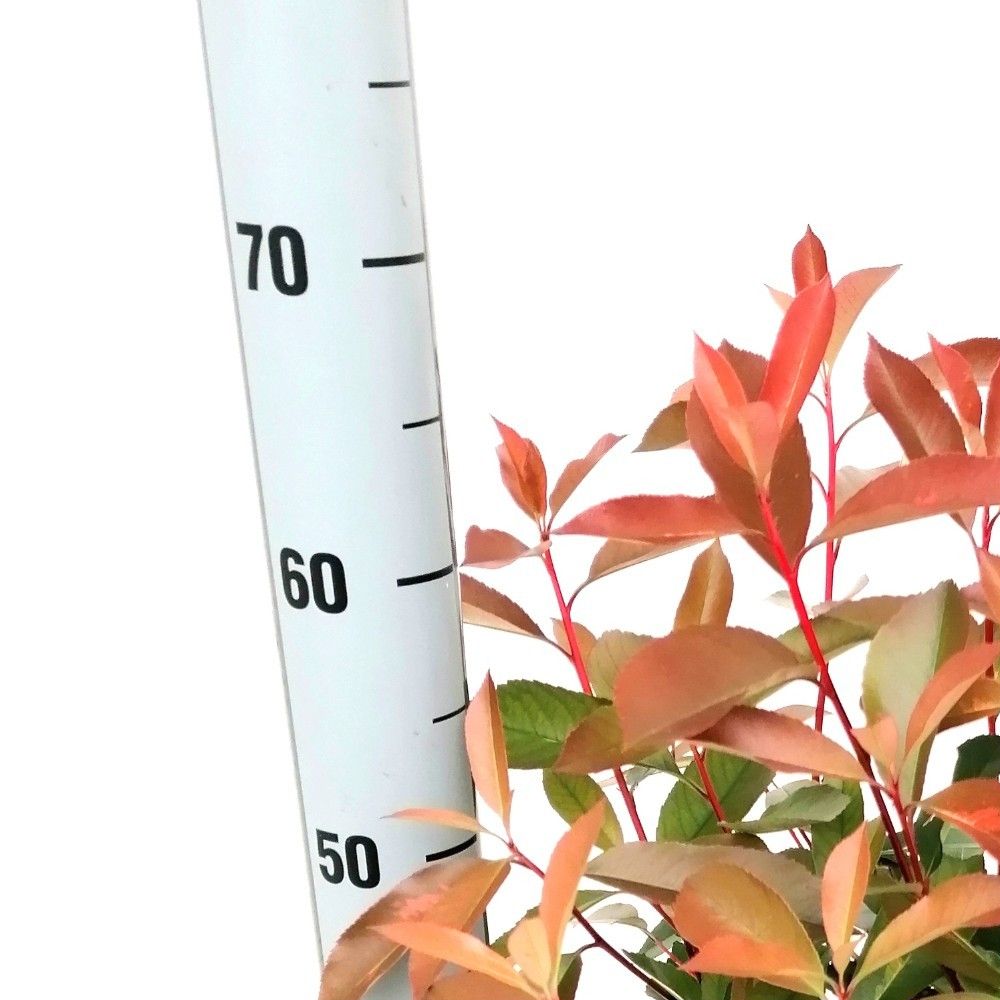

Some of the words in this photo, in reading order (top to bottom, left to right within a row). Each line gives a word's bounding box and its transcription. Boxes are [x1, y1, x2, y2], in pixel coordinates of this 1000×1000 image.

[236, 221, 309, 297] 70
[280, 548, 348, 614] 60
[316, 828, 380, 889] 50
